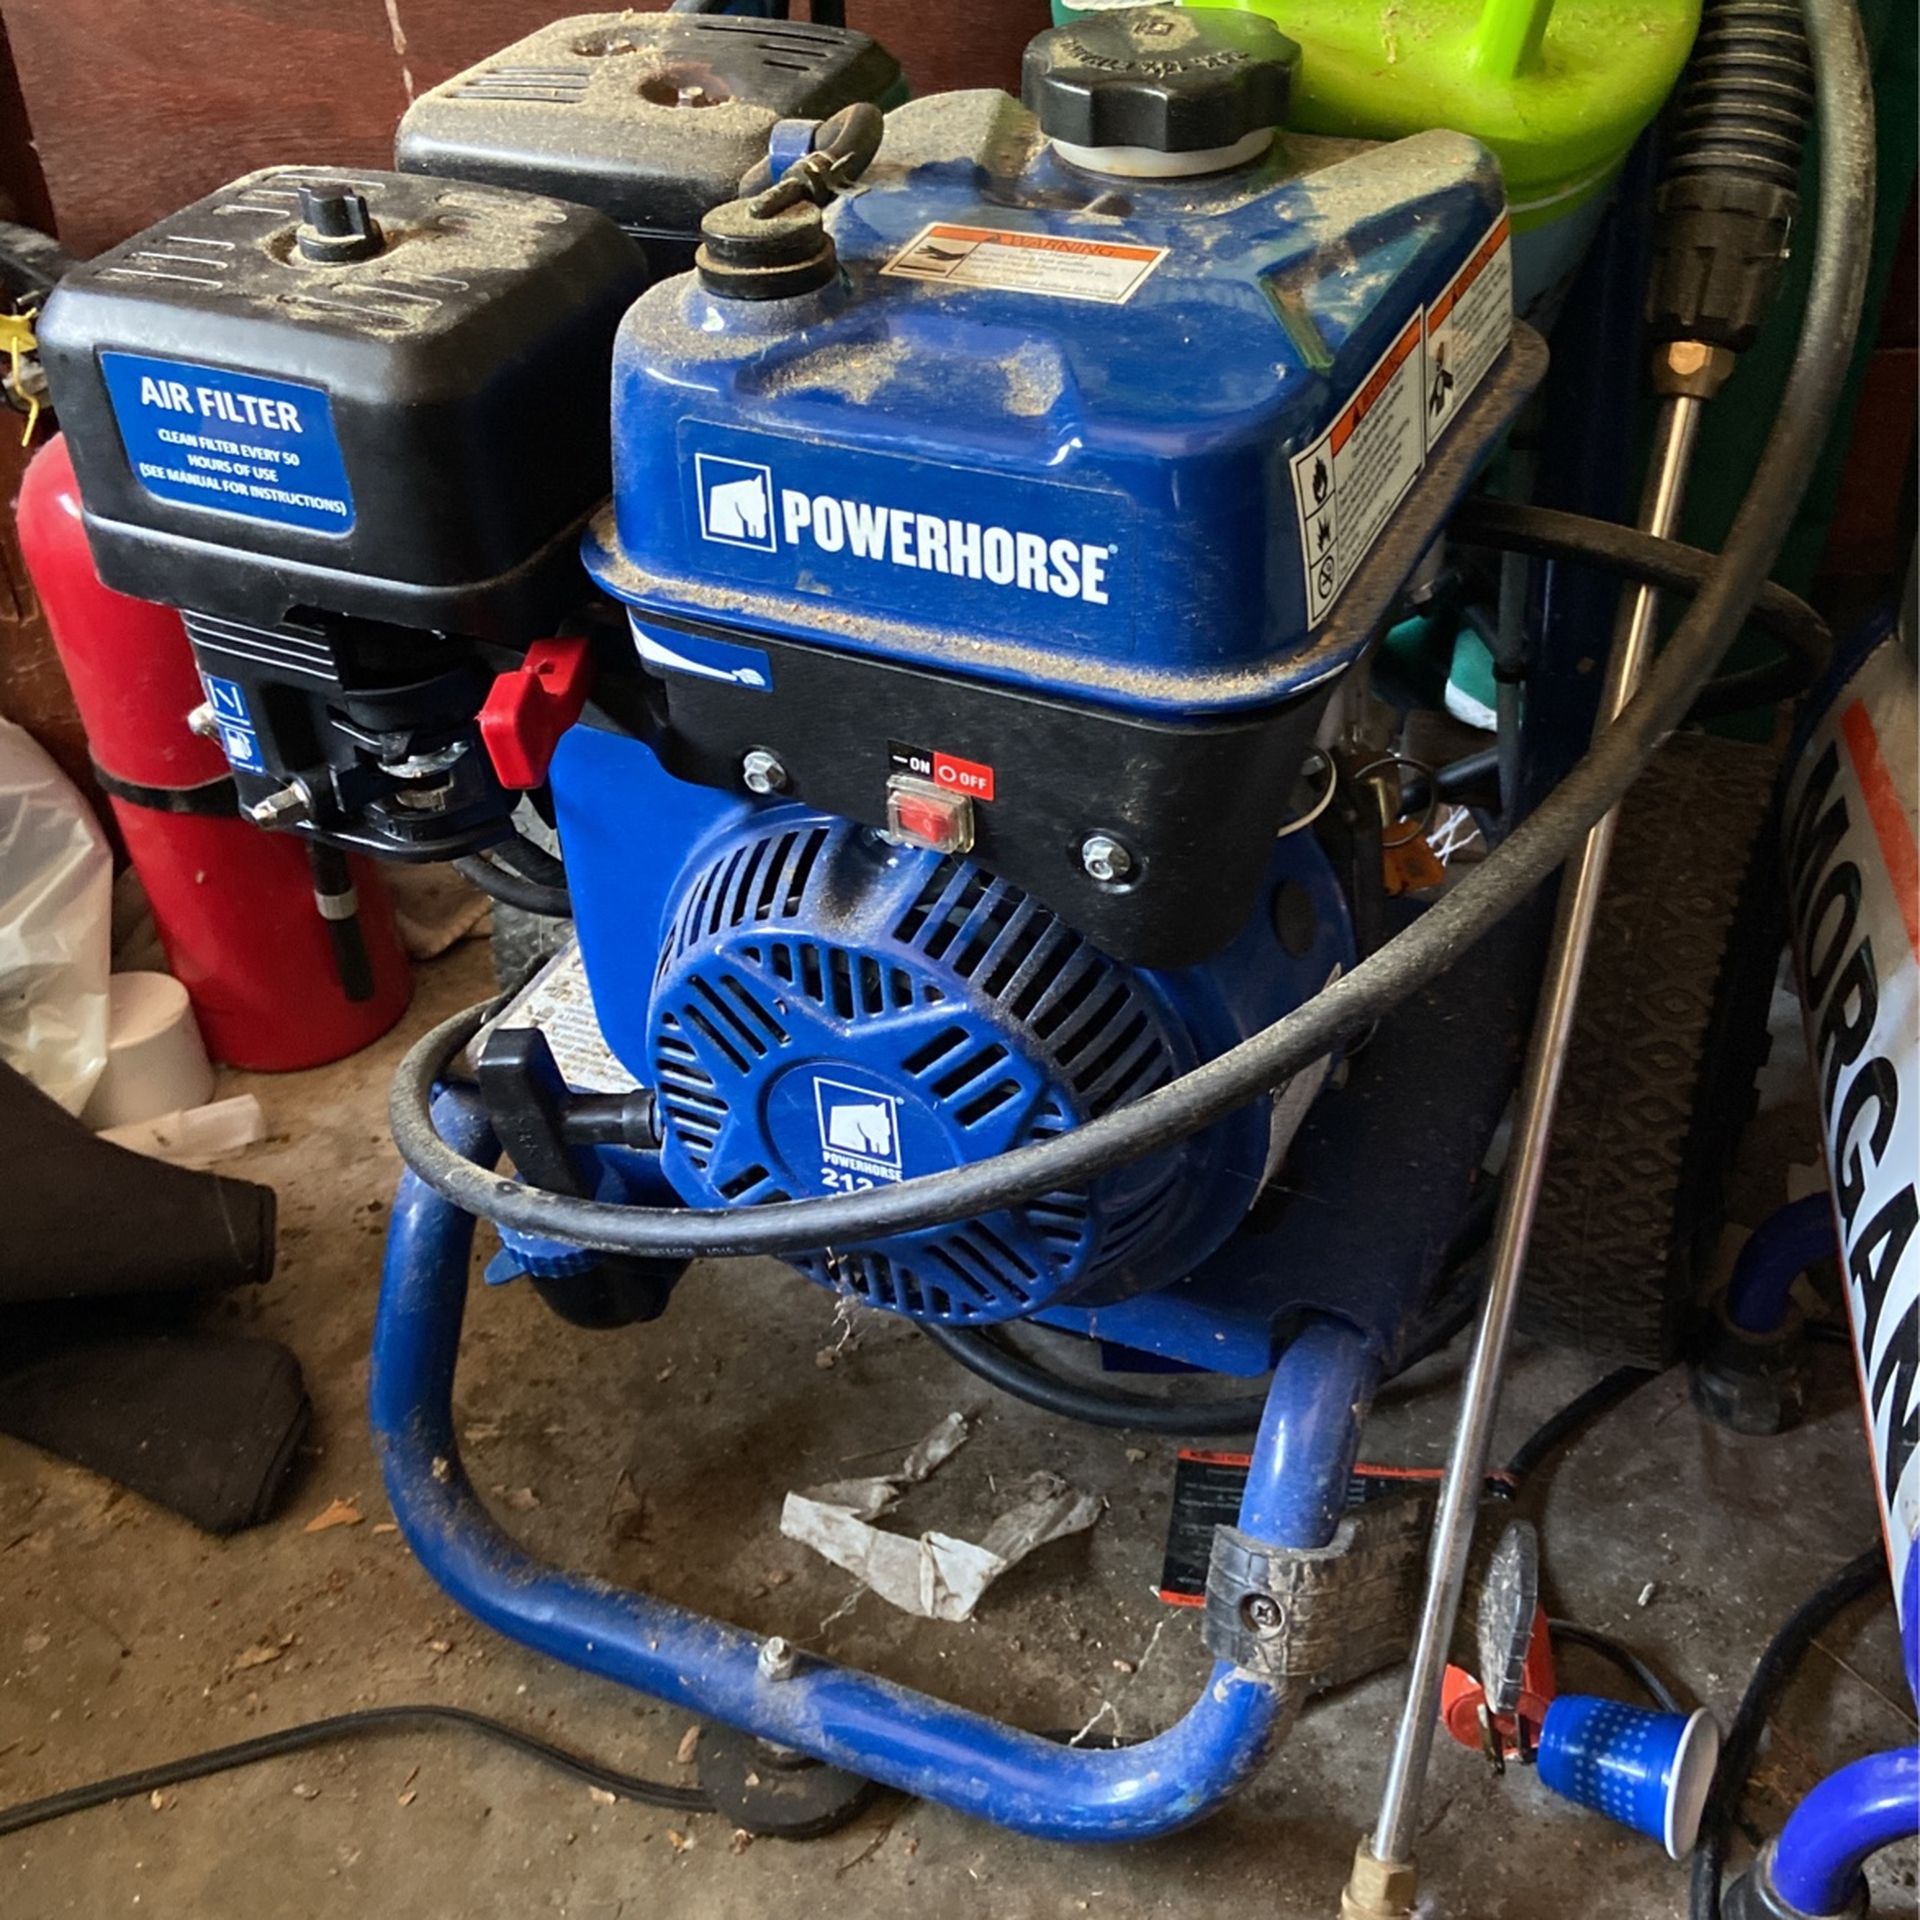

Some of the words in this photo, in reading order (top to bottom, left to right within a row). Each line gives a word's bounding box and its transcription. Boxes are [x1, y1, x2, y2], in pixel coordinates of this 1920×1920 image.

[1009, 234, 1116, 257] WARNING
[140, 376, 194, 413] AIR
[197, 387, 303, 433] FILTER
[158, 428, 198, 448] CLEAN
[199, 436, 240, 456] FILTER
[241, 445, 281, 464] EVERY
[282, 452, 300, 467] 50
[187, 454, 233, 475] HOURS
[234, 463, 250, 477] OF
[252, 467, 279, 483] USE
[139, 462, 167, 480] (SEE
[168, 467, 222, 492] MANUAL
[223, 481, 248, 497] FOR
[249, 487, 347, 517] INSTRUCTIONS)
[782, 488, 1110, 606] POWERHORSE
[909, 756, 931, 775] ON
[959, 771, 988, 790] OFF
[1786, 738, 1918, 1515] MORGAN
[822, 1150, 903, 1183] POWERHORSE
